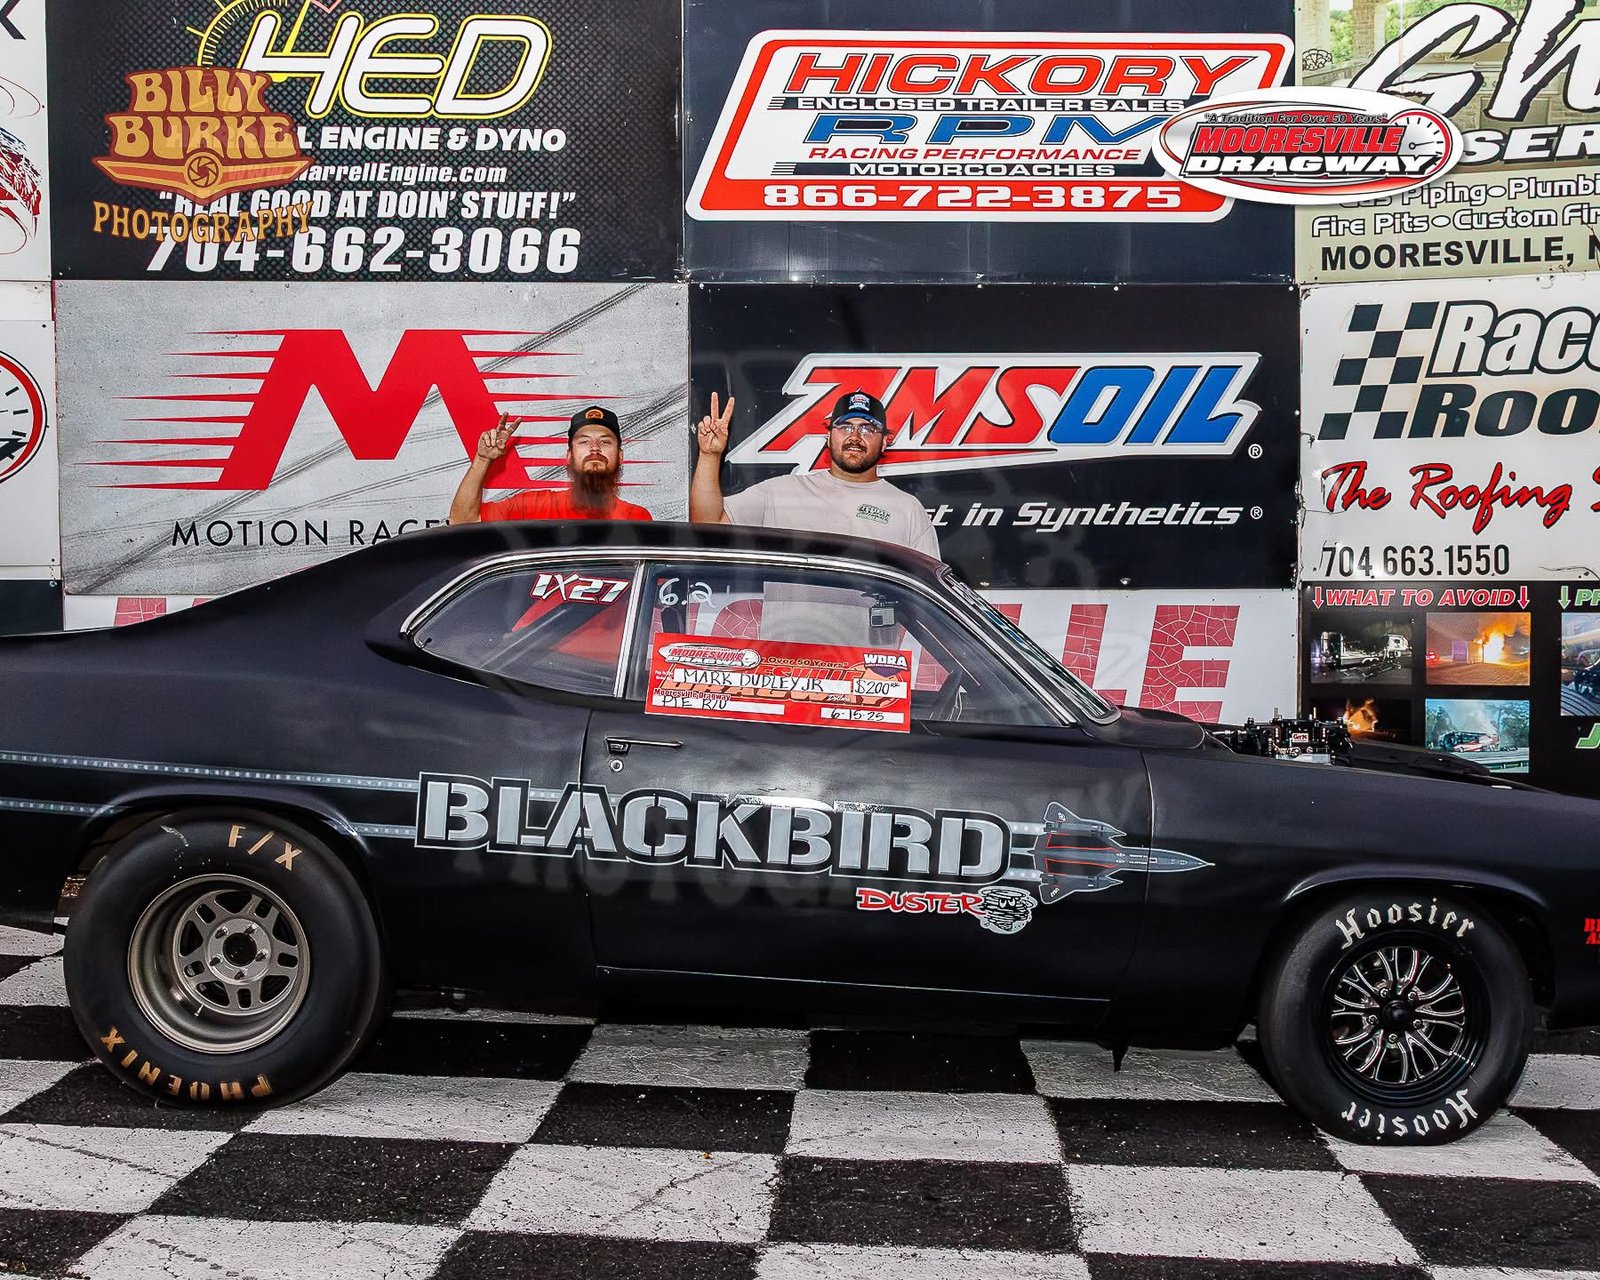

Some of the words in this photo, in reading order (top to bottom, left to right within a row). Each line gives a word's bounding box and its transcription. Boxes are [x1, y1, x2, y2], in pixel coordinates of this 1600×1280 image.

[783, 53, 1258, 96] HICKORY
[797, 98, 960, 112] ENCLOSED
[960, 98, 1083, 112] TRAILER
[1090, 99, 1186, 112] SALES
[319, 126, 440, 151] ENGINE
[446, 128, 470, 152] &
[475, 128, 567, 152] DYNO
[803, 113, 1176, 145] RPM
[808, 148, 919, 160] RACING
[922, 148, 1141, 161] PERFORMANCE
[849, 163, 1116, 176] MOTORCOACHES
[335, 190, 373, 218] AT
[763, 184, 1181, 209] 866-722-3875
[1311, 215, 1365, 238] Fire
[1373, 212, 1430, 236] Pits
[1452, 207, 1558, 231] Custom
[1320, 235, 1575, 271] MOORESVILLE,
[1425, 300, 1600, 378] Rac
[745, 360, 1252, 470] AMSOIL
[1321, 460, 1392, 513] The
[1409, 461, 1573, 536] Roofing
[961, 502, 1004, 526] in
[1011, 501, 1244, 533] Synthetics
[171, 520, 328, 546] MOTION
[1325, 588, 1395, 606] WHAT
[1400, 588, 1433, 606] TO
[1437, 588, 1517, 606] AVOID
[768, 657, 795, 666] Over
[863, 653, 907, 668] WDRA
[653, 687, 697, 700] Mooresville
[684, 668, 732, 686] MARK
[740, 674, 801, 692] DUDLEY
[801, 678, 824, 692] JR
[415, 772, 1010, 883] BLACKBIRD
[856, 887, 989, 916] DUSTER
[1334, 897, 1476, 951] Hoosier
[99, 1025, 274, 1102] PHOENIX
[1340, 1087, 1479, 1141] Hoosier
